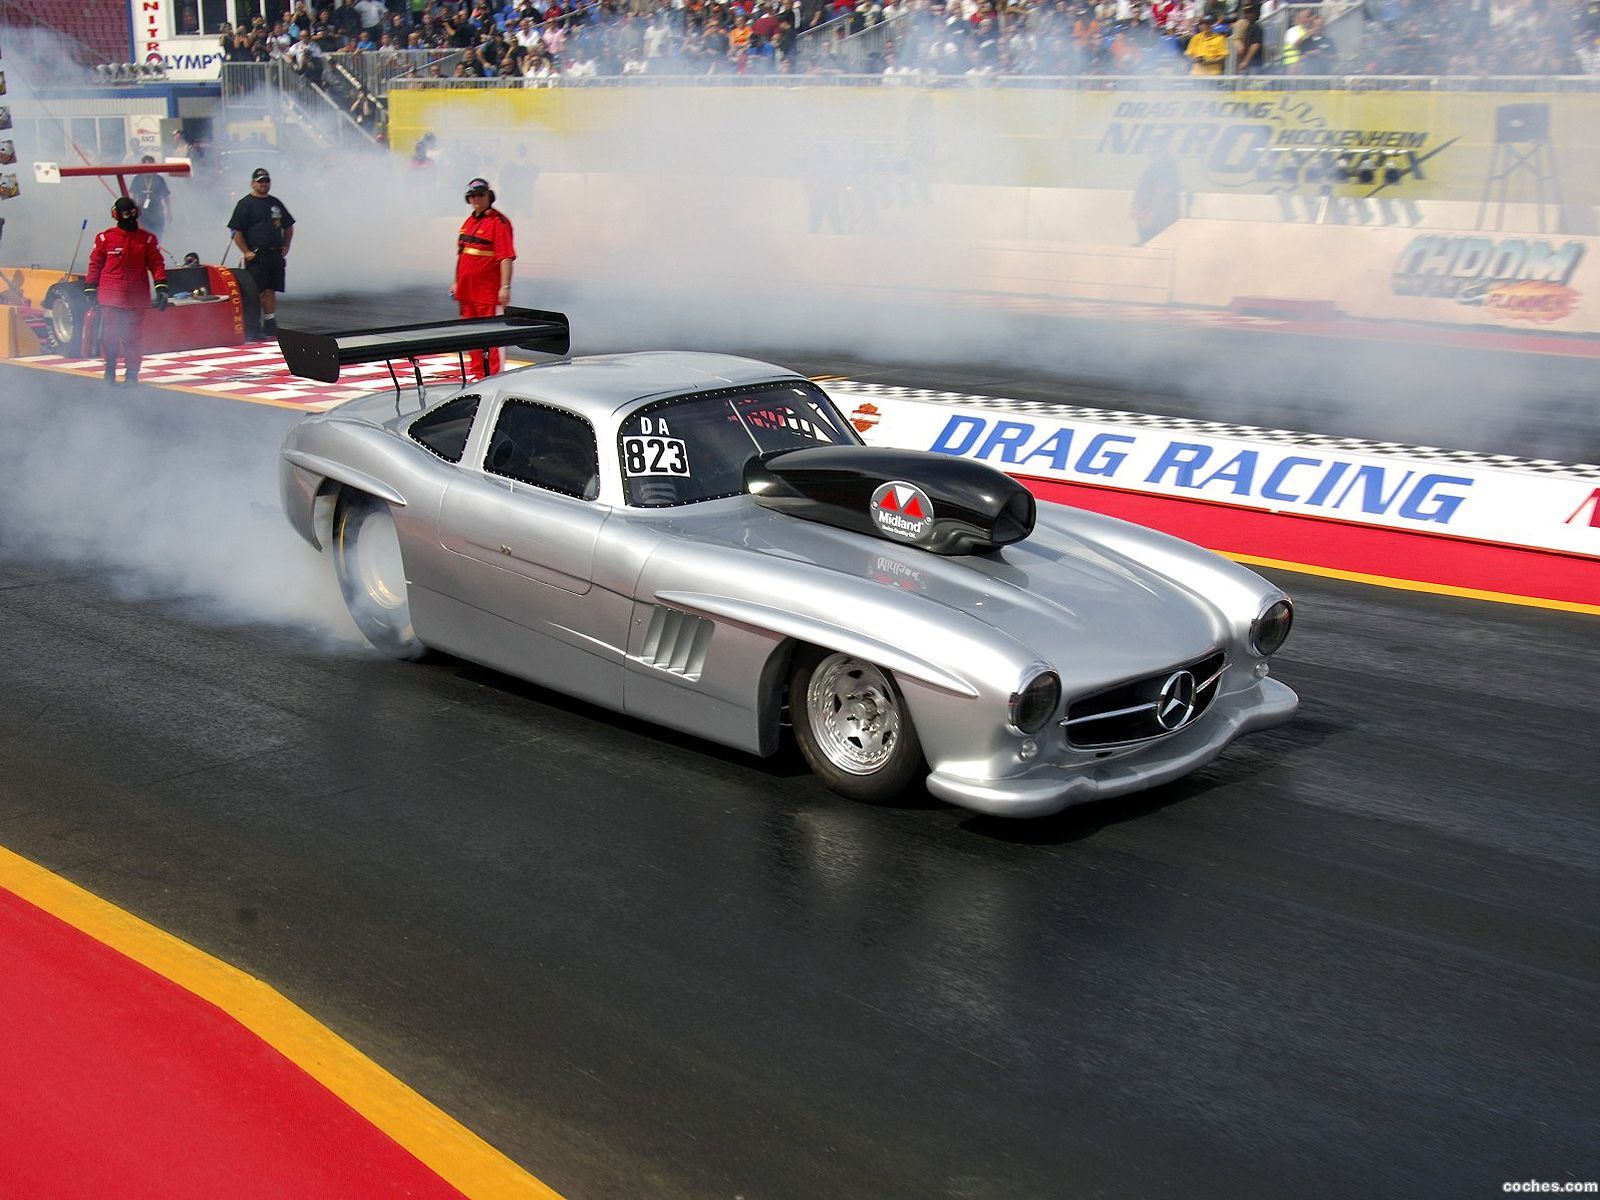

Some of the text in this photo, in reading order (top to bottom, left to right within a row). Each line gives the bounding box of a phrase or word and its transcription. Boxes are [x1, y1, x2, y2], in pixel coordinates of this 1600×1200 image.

[1115, 101, 1274, 119] DRAG RACING
[1276, 129, 1429, 148] HOCKENHEIM
[625, 438, 688, 474] 823
[928, 414, 1137, 478] DRAG
[1143, 441, 1475, 525] RACING
[879, 510, 923, 533] Midland
